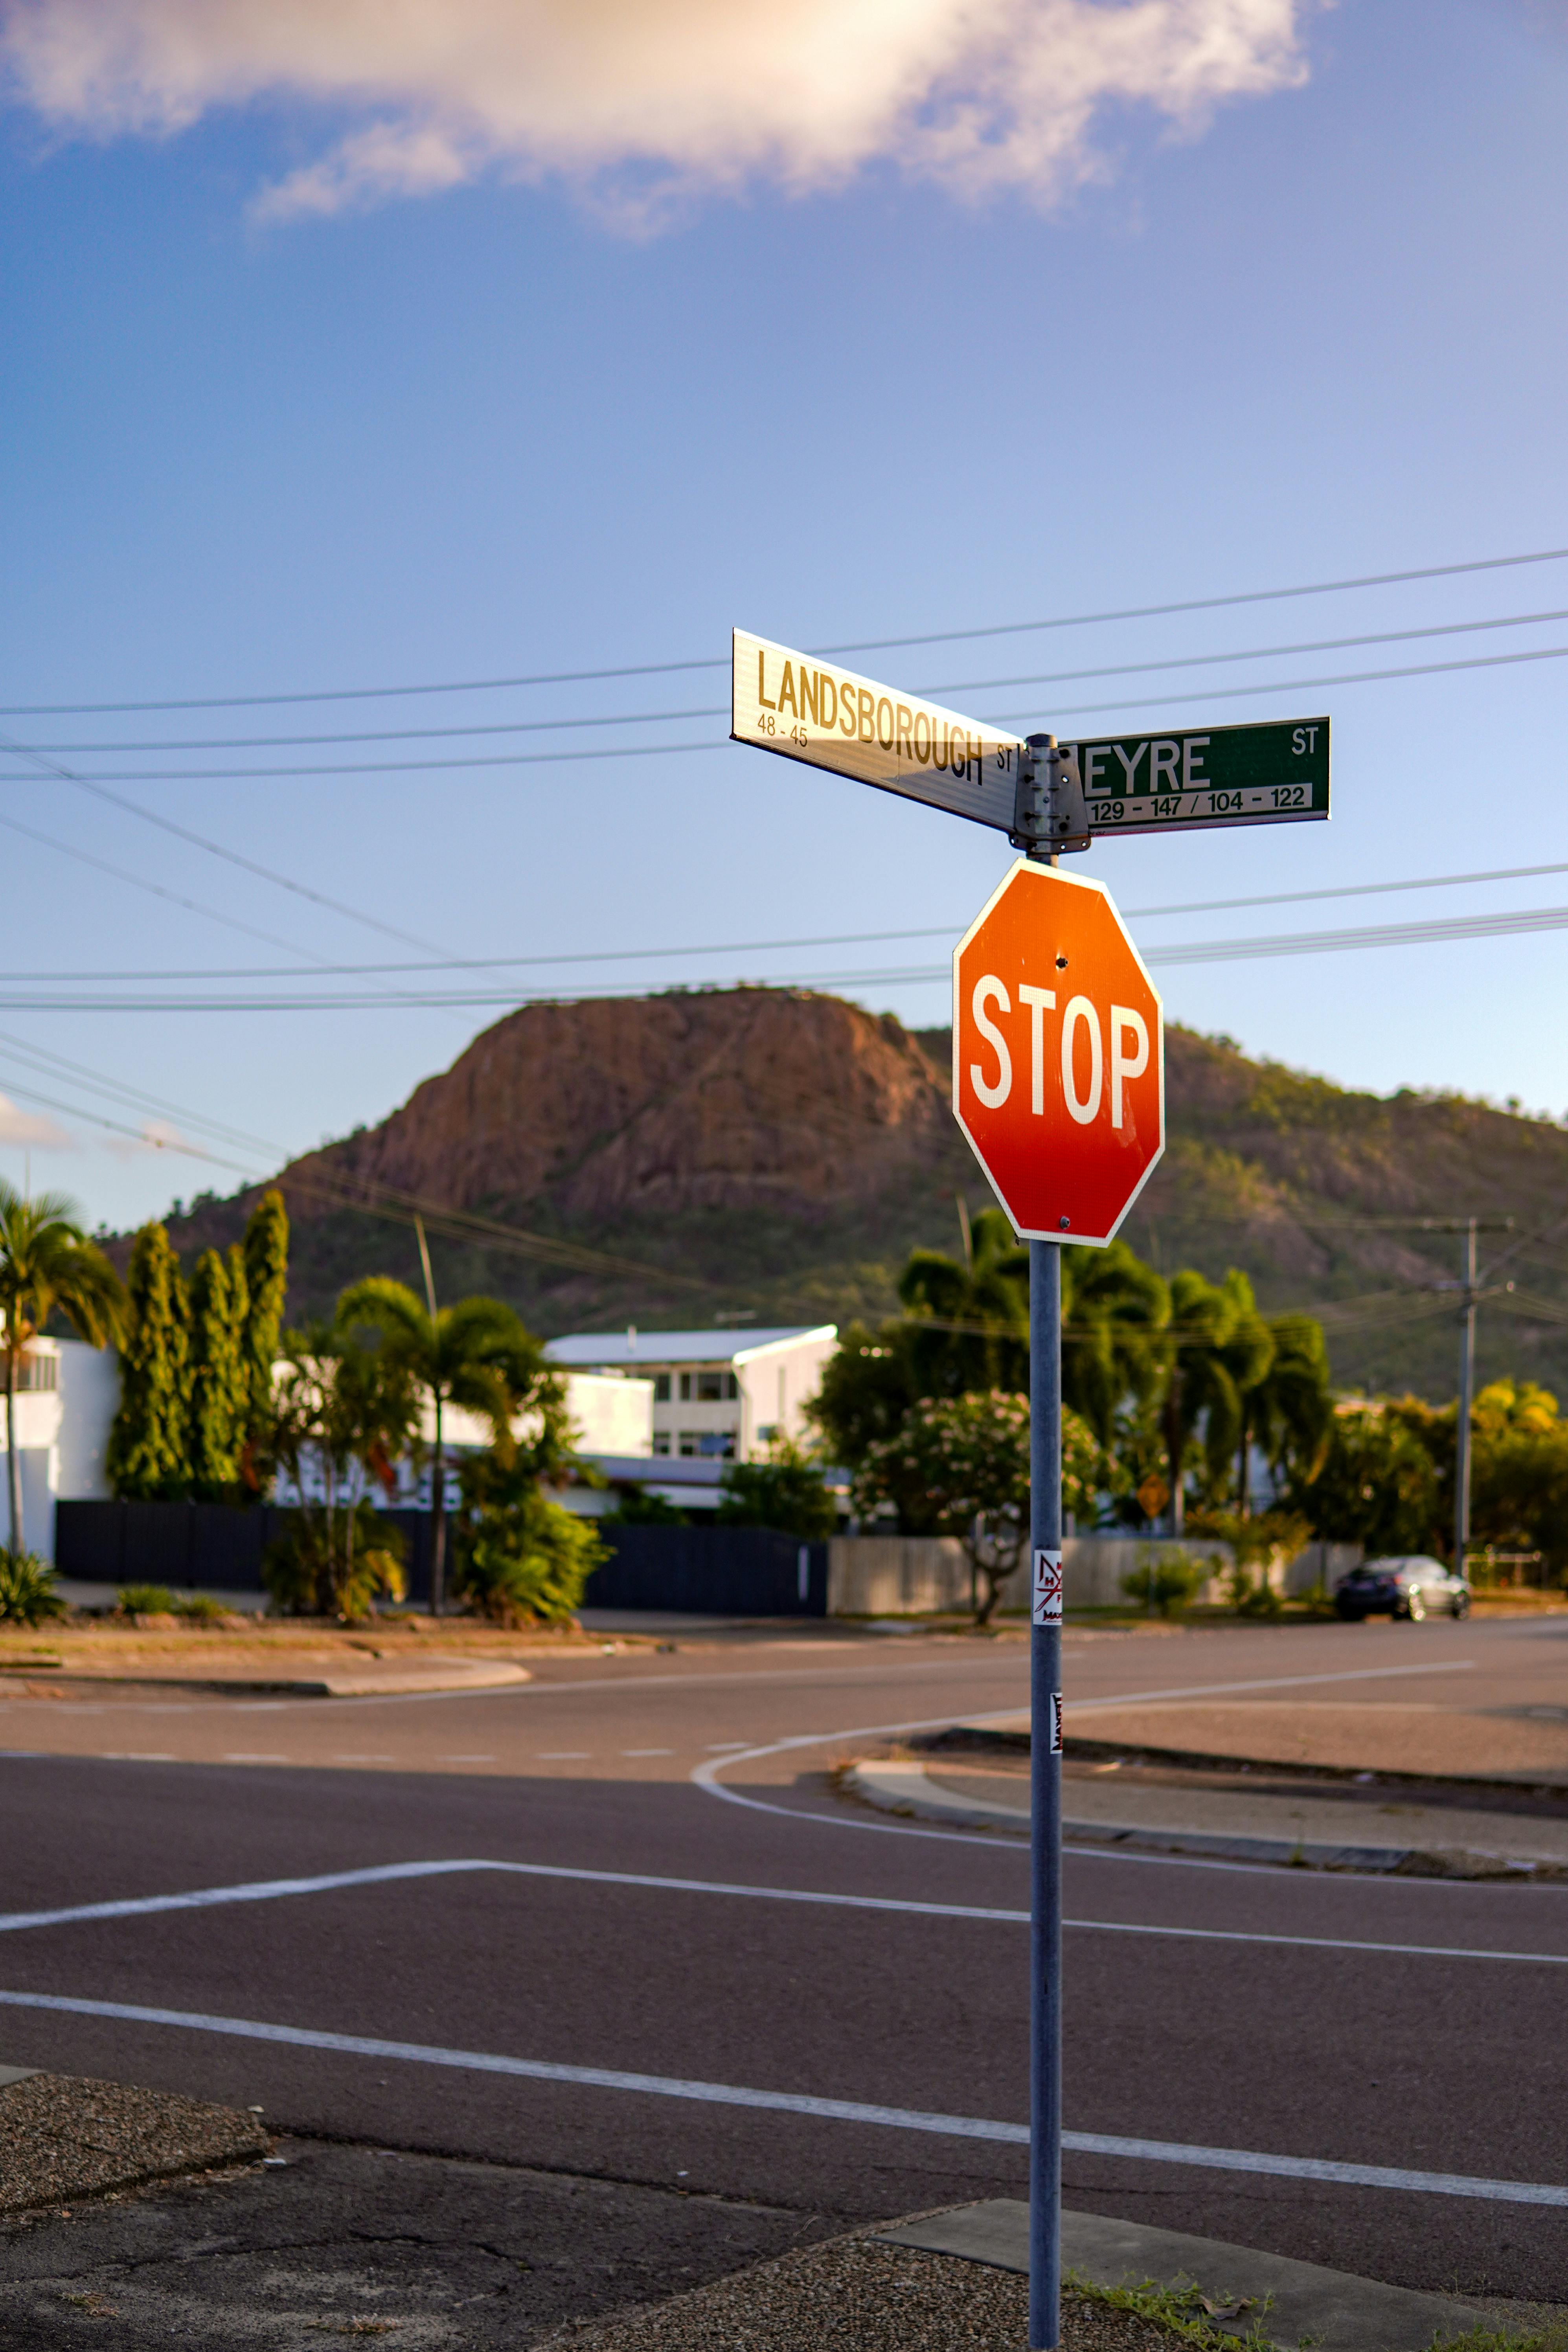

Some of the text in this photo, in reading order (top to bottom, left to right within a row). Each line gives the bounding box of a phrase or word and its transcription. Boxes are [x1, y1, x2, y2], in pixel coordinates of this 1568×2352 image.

[757, 713, 775, 736] 48
[790, 725, 808, 747] 45
[759, 650, 1012, 786] LANDSBOROUGH ST
[1084, 727, 1319, 798] EYRE ST
[1091, 801, 1124, 821] 129
[1151, 796, 1182, 817] 147
[1208, 791, 1243, 812] 104
[1270, 787, 1304, 807] 122
[970, 974, 1149, 1129] STOP
